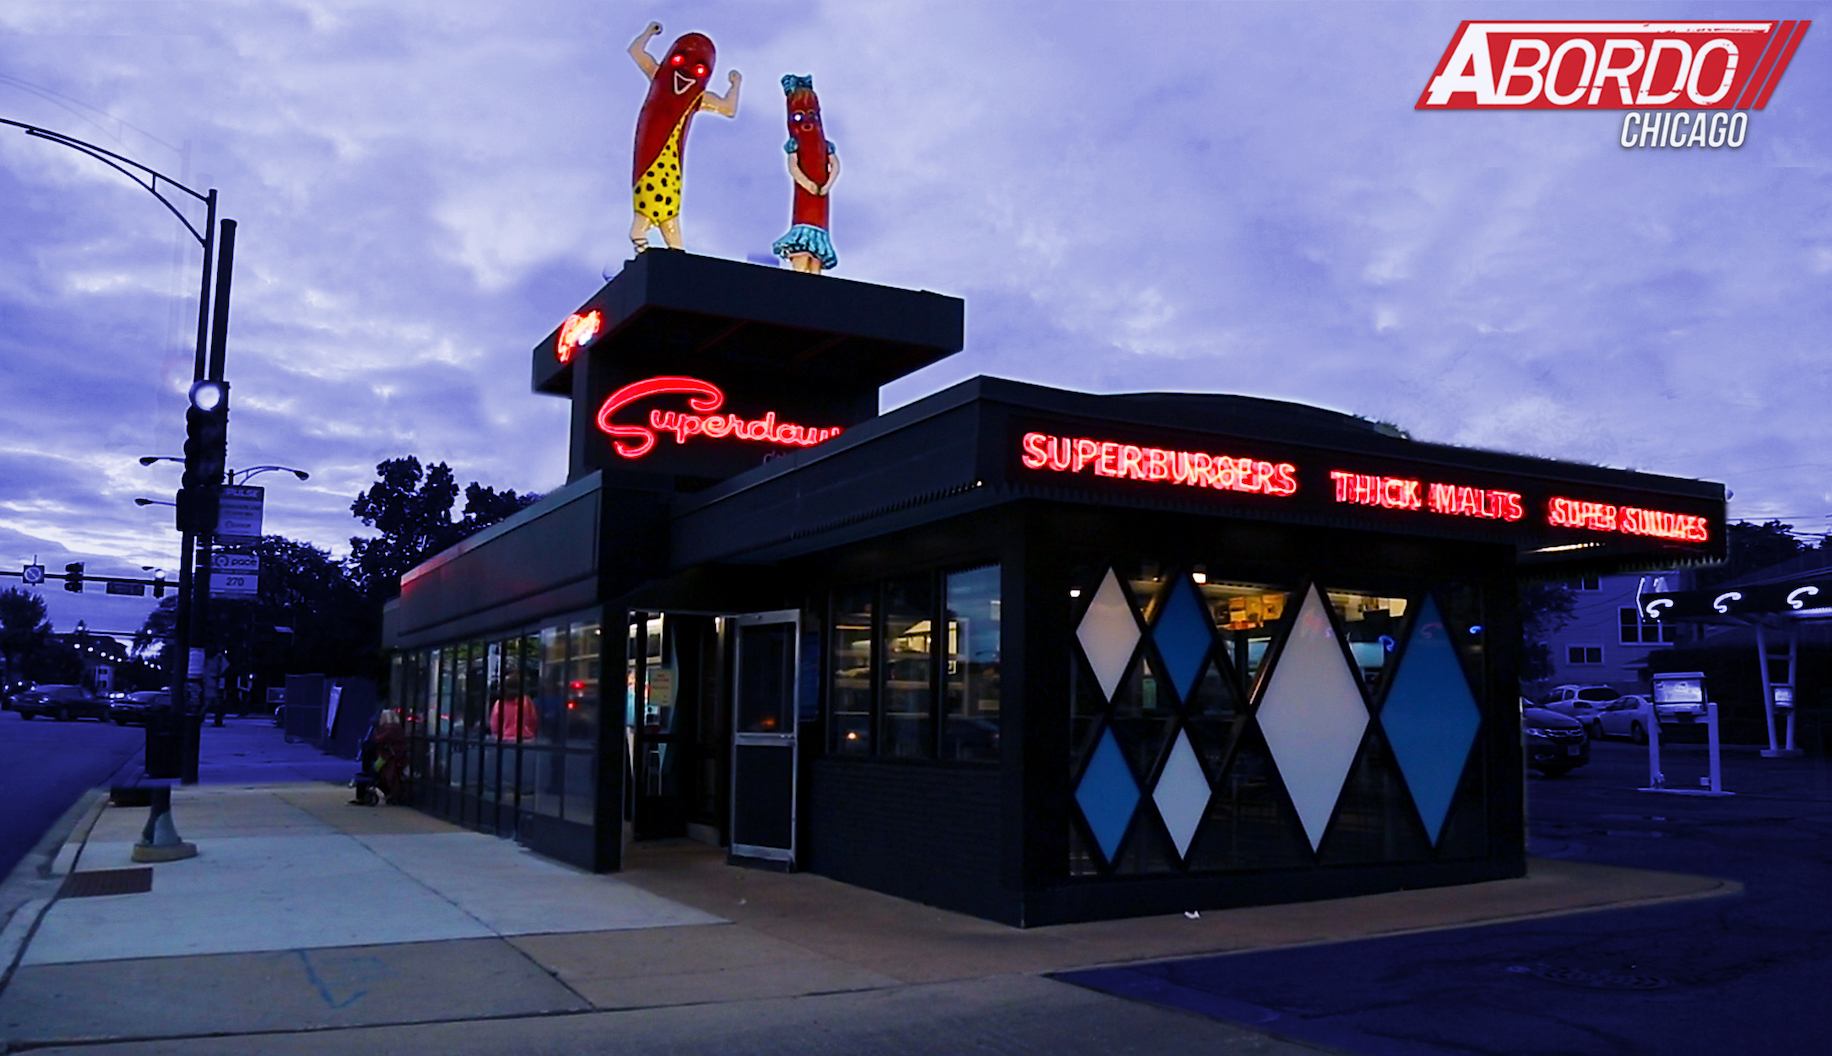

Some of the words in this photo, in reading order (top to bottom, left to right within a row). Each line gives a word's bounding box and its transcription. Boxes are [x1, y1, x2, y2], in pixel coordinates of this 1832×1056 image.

[597, 375, 843, 459] Superdaw
[1021, 431, 1299, 498] SUPERBURGERS
[1330, 470, 1421, 508] THICK
[1429, 482, 1524, 522] MALTS
[1548, 496, 1618, 532] SUPER
[226, 576, 245, 587] 270
